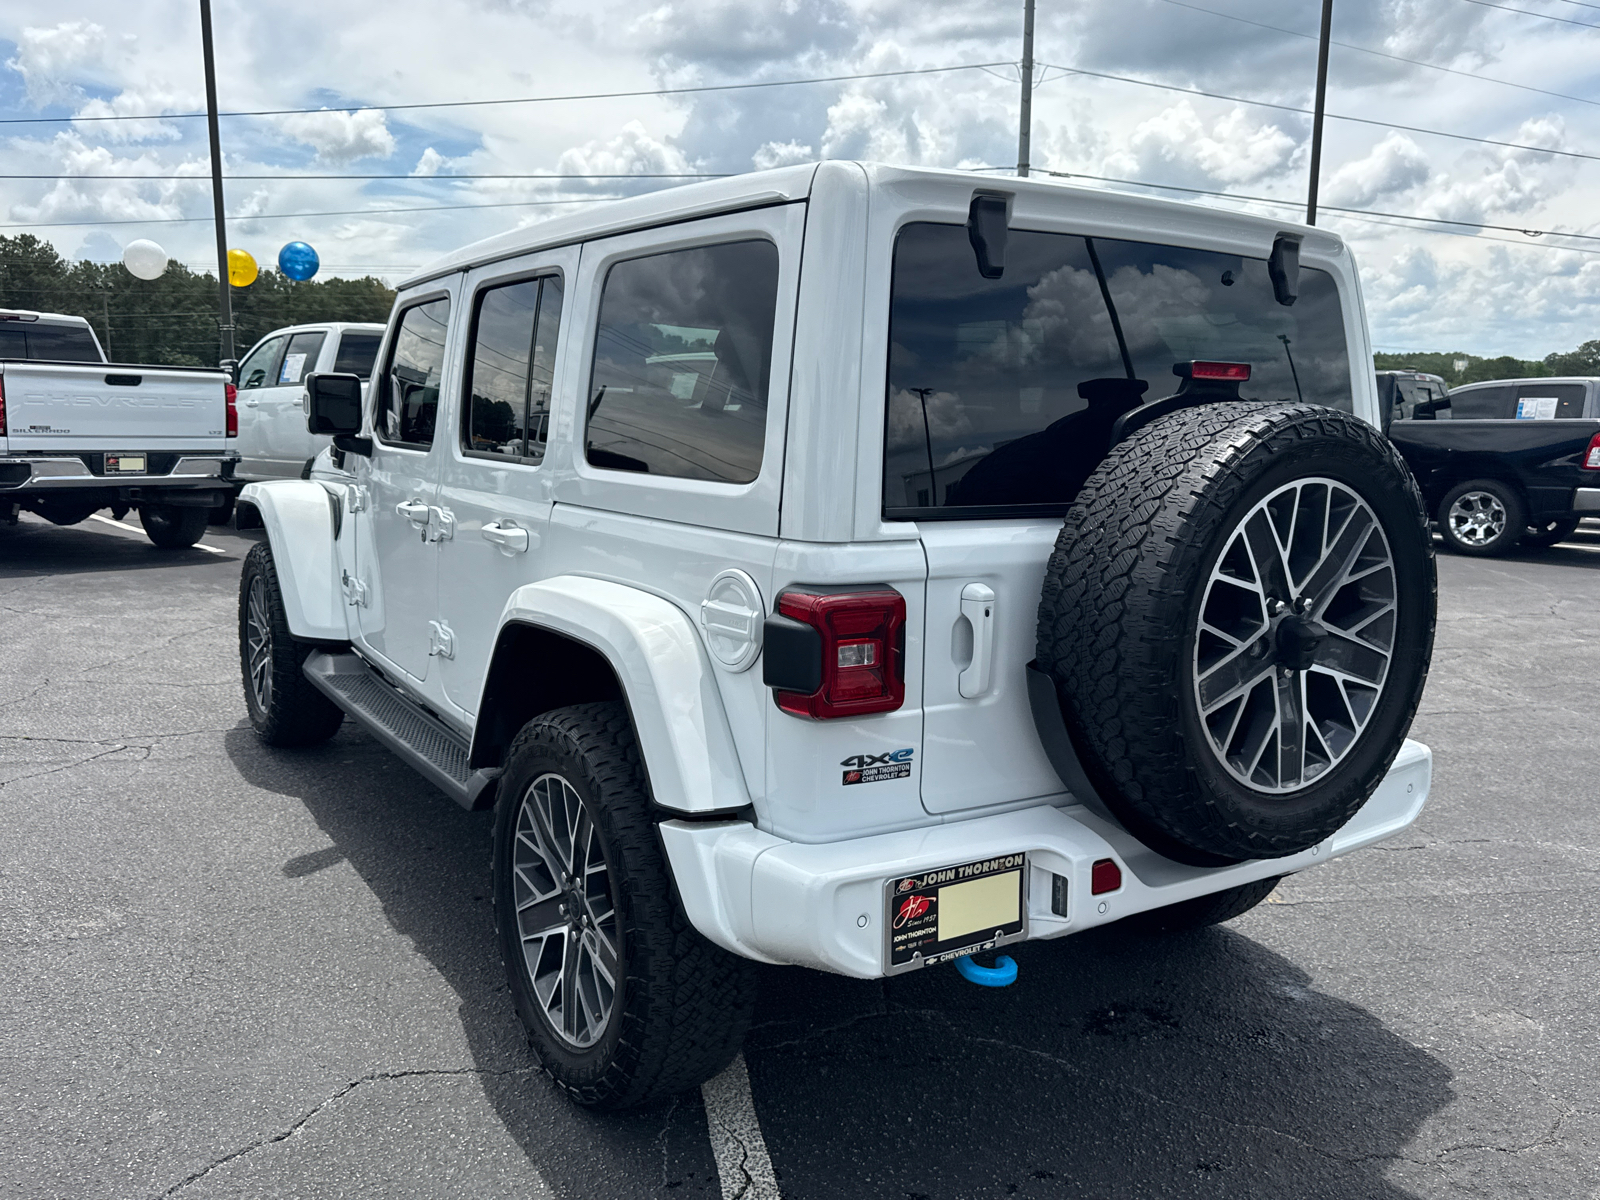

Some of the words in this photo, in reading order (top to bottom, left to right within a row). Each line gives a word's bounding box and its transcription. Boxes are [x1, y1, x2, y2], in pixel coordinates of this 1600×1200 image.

[23, 393, 213, 409] CHEVROLET
[862, 772, 898, 782] CHEVROLET
[863, 768, 878, 777] JOHN
[879, 764, 910, 774] THORNTON
[922, 868, 956, 887] JOHN
[959, 855, 1023, 877] THORNTON
[893, 934, 908, 943] JOHN
[907, 926, 937, 939] THORNTON
[940, 945, 981, 962] CHEVROLET
